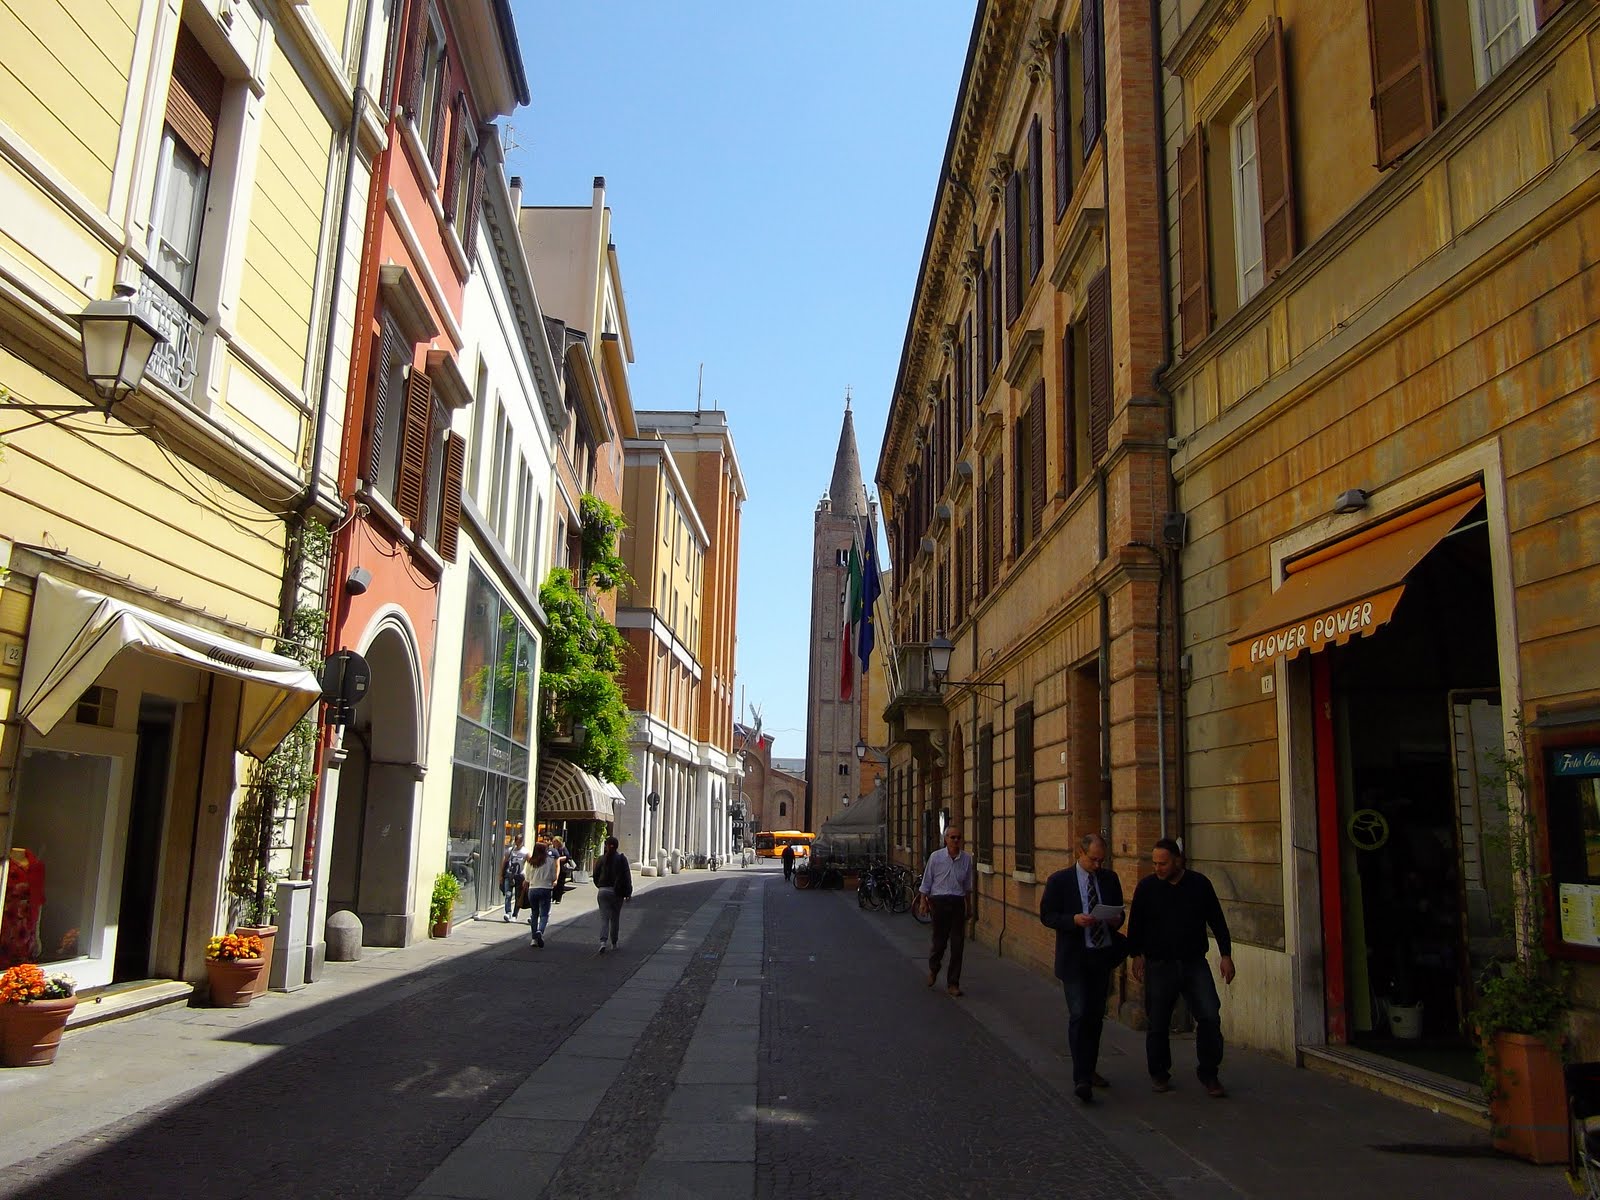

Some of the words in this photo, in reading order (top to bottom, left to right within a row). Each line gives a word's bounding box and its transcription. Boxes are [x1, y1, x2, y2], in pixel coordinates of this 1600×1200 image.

[1250, 624, 1306, 663] FLOWER
[1313, 602, 1373, 642] POWER
[9, 648, 19, 660] 22
